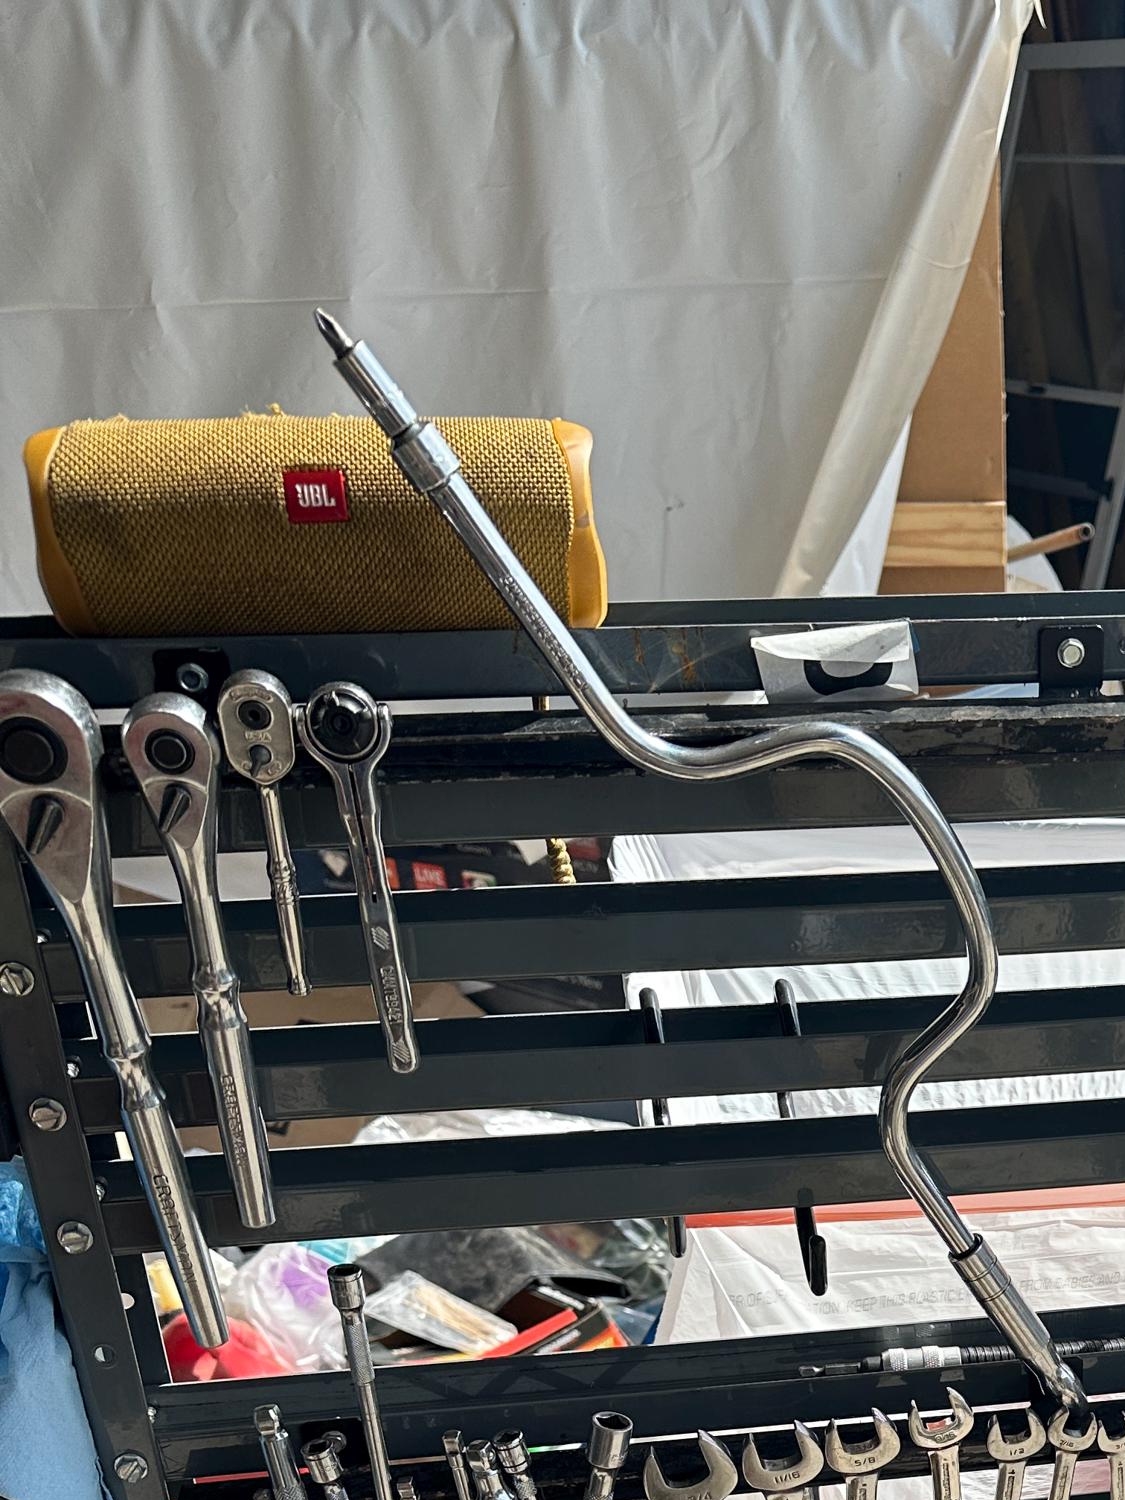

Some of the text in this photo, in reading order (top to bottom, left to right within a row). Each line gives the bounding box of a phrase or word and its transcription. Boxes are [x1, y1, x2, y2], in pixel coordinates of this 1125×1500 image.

[295, 483, 336, 508] JBL
[152, 1173, 198, 1288] CRAFTSMAN
[854, 1456, 876, 1467] 5/8
[774, 1470, 800, 1484] 11/16
